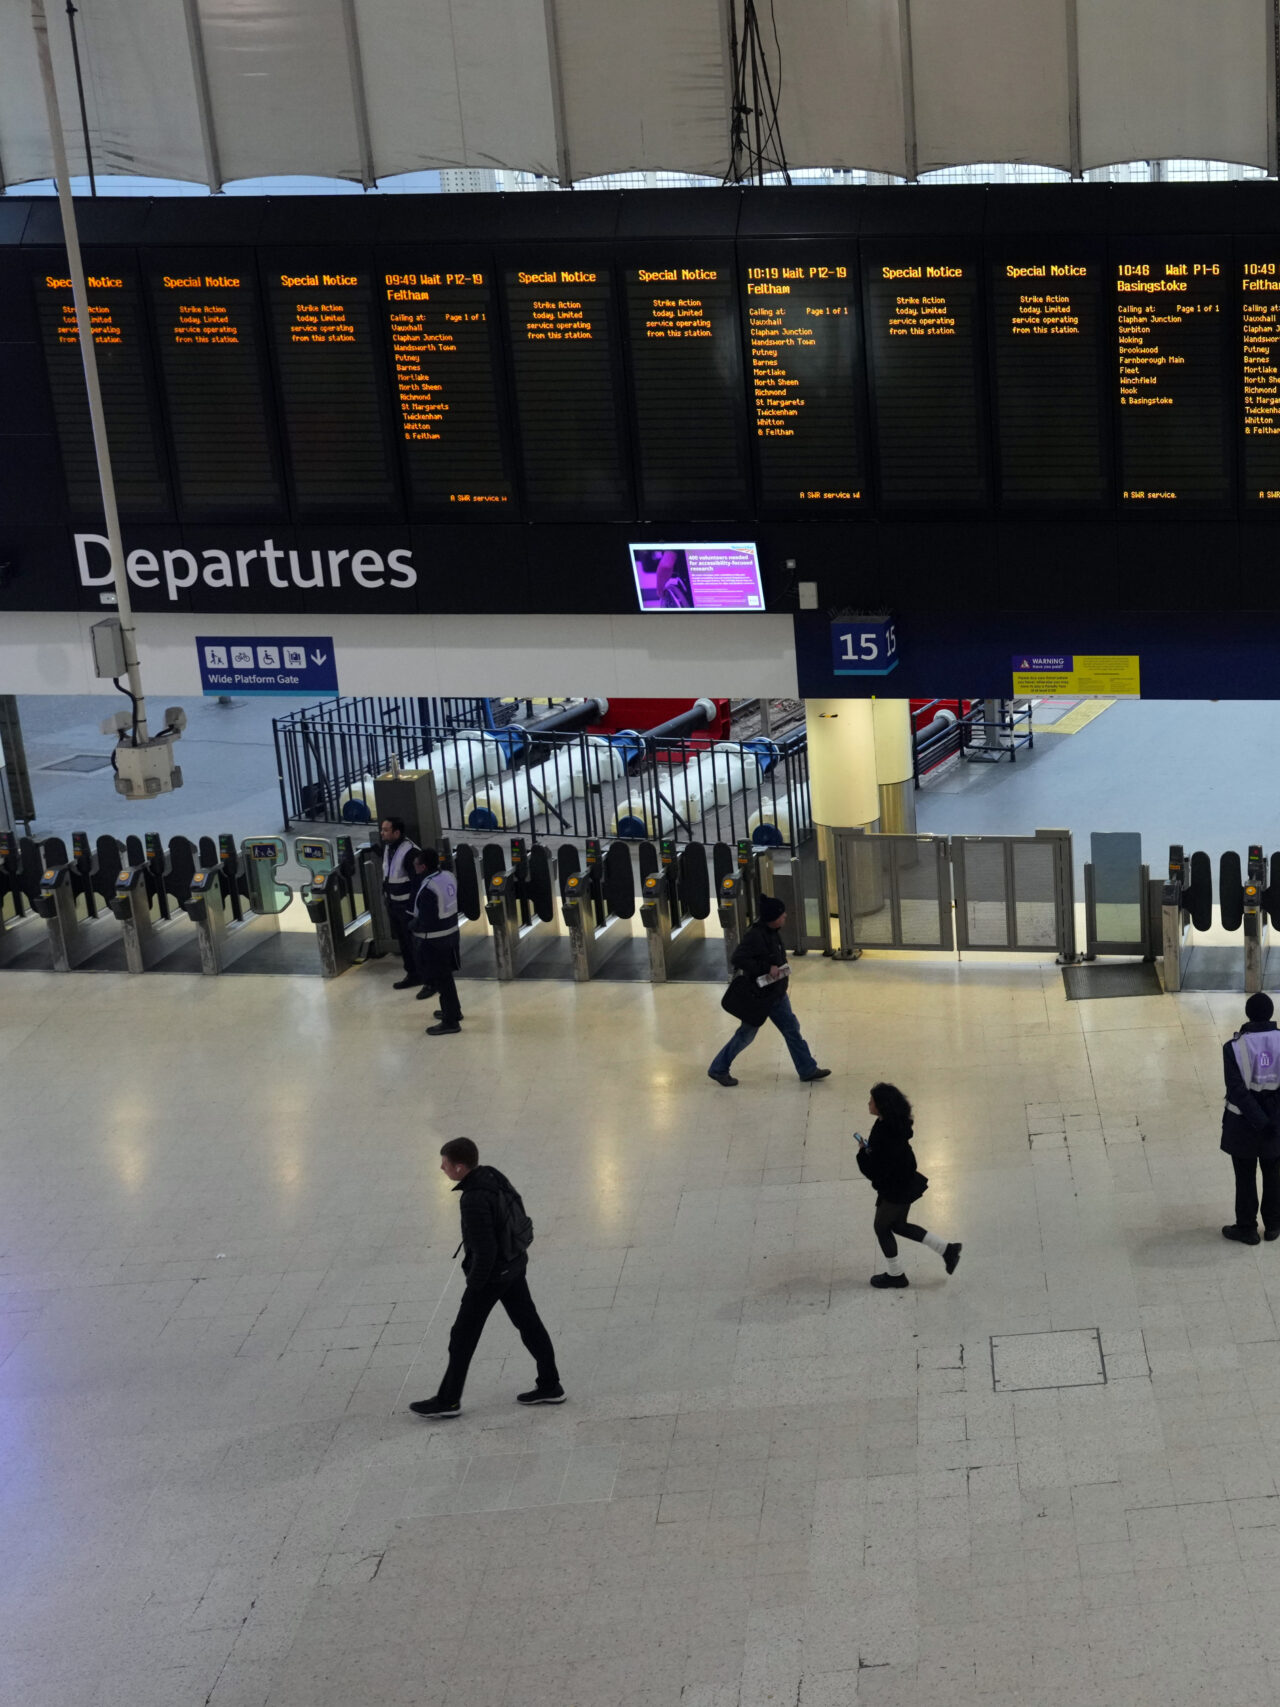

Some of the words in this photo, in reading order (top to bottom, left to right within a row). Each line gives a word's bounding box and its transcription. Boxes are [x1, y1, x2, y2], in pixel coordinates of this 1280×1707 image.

[749, 268, 778, 278] 10:19
[783, 268, 804, 278] Wait
[810, 267, 846, 278] P12-19
[883, 267, 921, 279] Special
[927, 267, 962, 277] Notice
[1007, 266, 1045, 277] Special
[1051, 265, 1086, 275] Notice
[1166, 265, 1187, 275] Wait
[1194, 264, 1219, 275] P1-6
[1245, 264, 1275, 274] 10:49
[281, 276, 319, 287] Special
[323, 275, 357, 285] Notice
[385, 274, 417, 285] 09:49
[420, 274, 442, 285] Wait
[446, 274, 483, 285] P12-19
[519, 272, 556, 284] Special
[562, 272, 595, 282] Notice
[639, 270, 677, 281] Special
[682, 270, 716, 279] Notice
[88, 277, 123, 288] Notice
[164, 277, 201, 288] Special
[206, 277, 239, 286] Notice
[1118, 281, 1186, 292] Basingstoke
[748, 284, 790, 294] Feltham
[388, 290, 429, 300] Feltham
[1118, 305, 1142, 314] Calling
[1177, 304, 1194, 313] Page
[1204, 304, 1212, 312] of
[180, 316, 201, 324] today.
[1119, 315, 1147, 324] Clapham
[203, 326, 237, 334] operating
[1119, 325, 1150, 333] Surbiton
[1119, 336, 1143, 344] Woking
[1120, 356, 1166, 365] Farnborough
[1120, 366, 1139, 374] Fleet
[1120, 376, 1156, 384] Winchfield
[1121, 386, 1137, 394] Hook
[1129, 396, 1172, 405] Basingstoke
[74, 533, 417, 601] Departures
[885, 625, 896, 657] 15
[839, 633, 878, 661] 15
[208, 674, 232, 684] Wide
[234, 674, 276, 685] Platform
[277, 674, 300, 685] Gate
